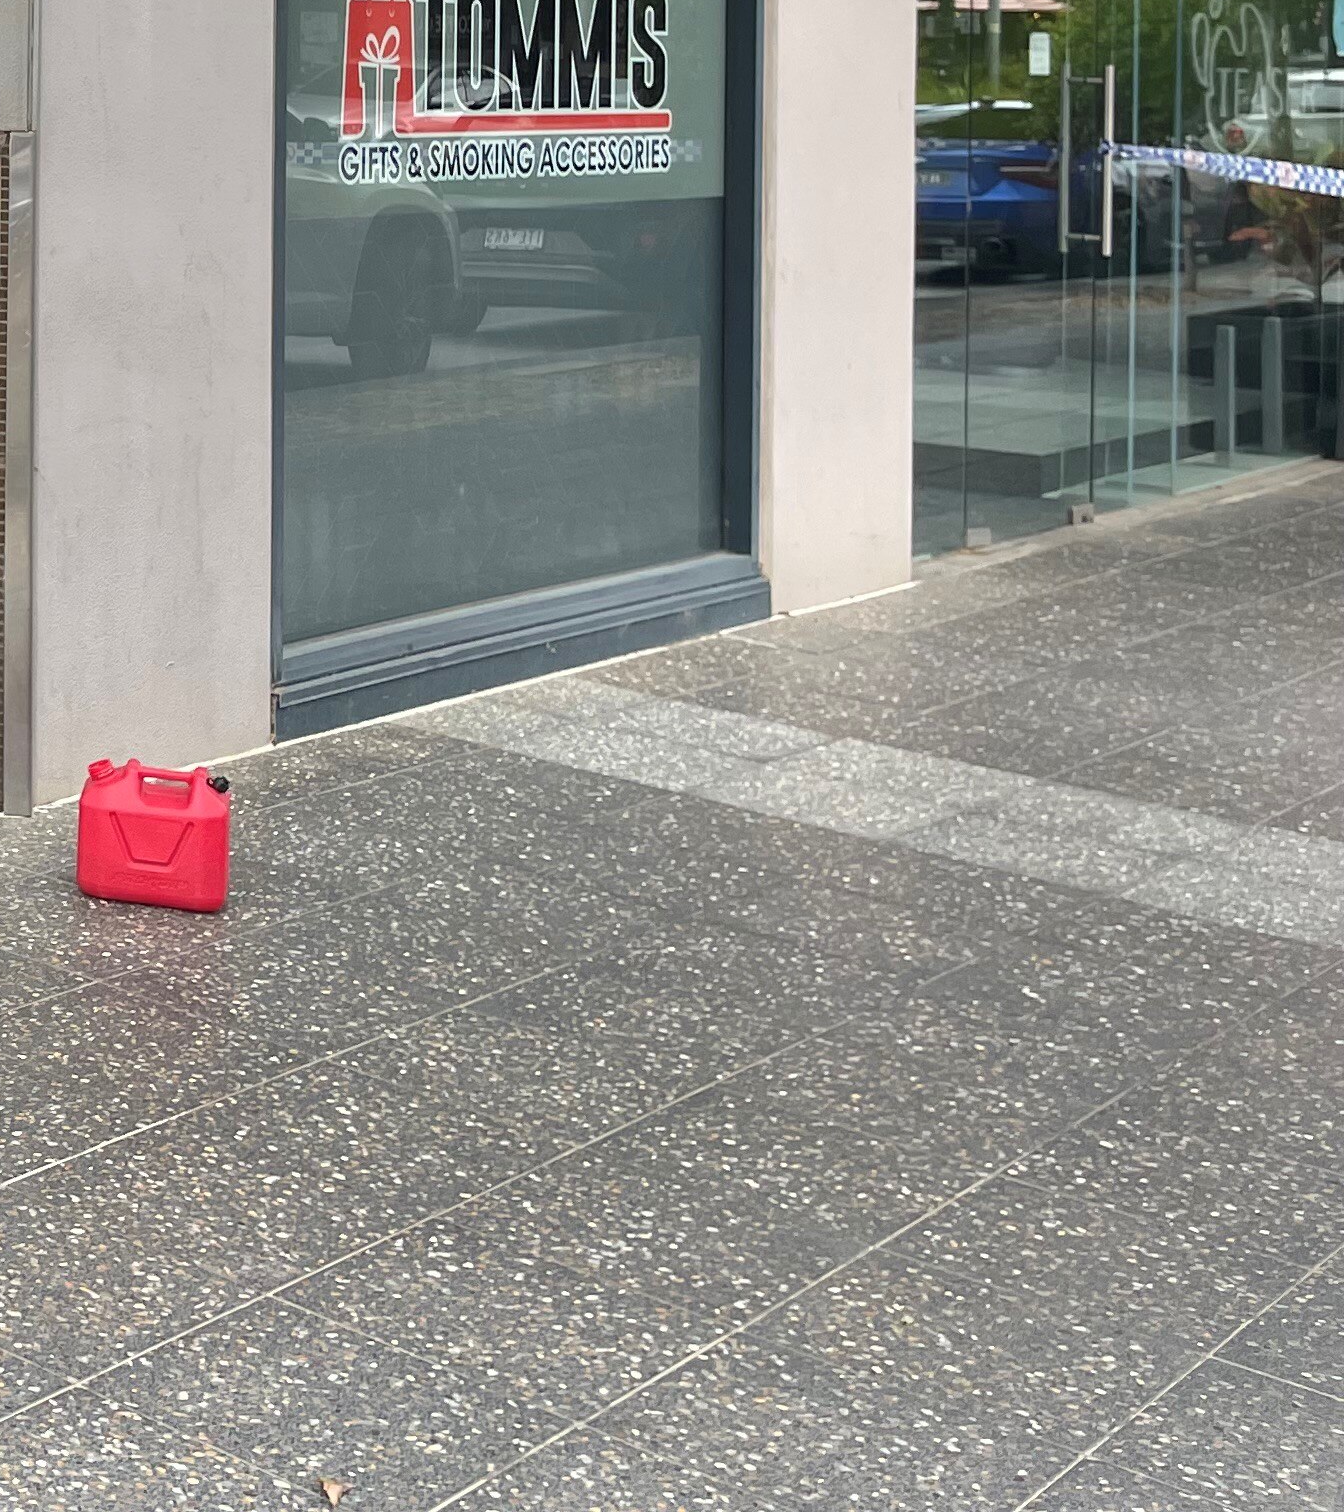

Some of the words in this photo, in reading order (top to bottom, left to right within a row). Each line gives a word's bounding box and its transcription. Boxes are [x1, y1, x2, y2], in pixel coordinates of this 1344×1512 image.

[340, 141, 401, 185] GIFTS
[406, 142, 426, 180] &
[427, 138, 534, 182] SMOKING
[538, 135, 670, 179] ACCESSORIES
